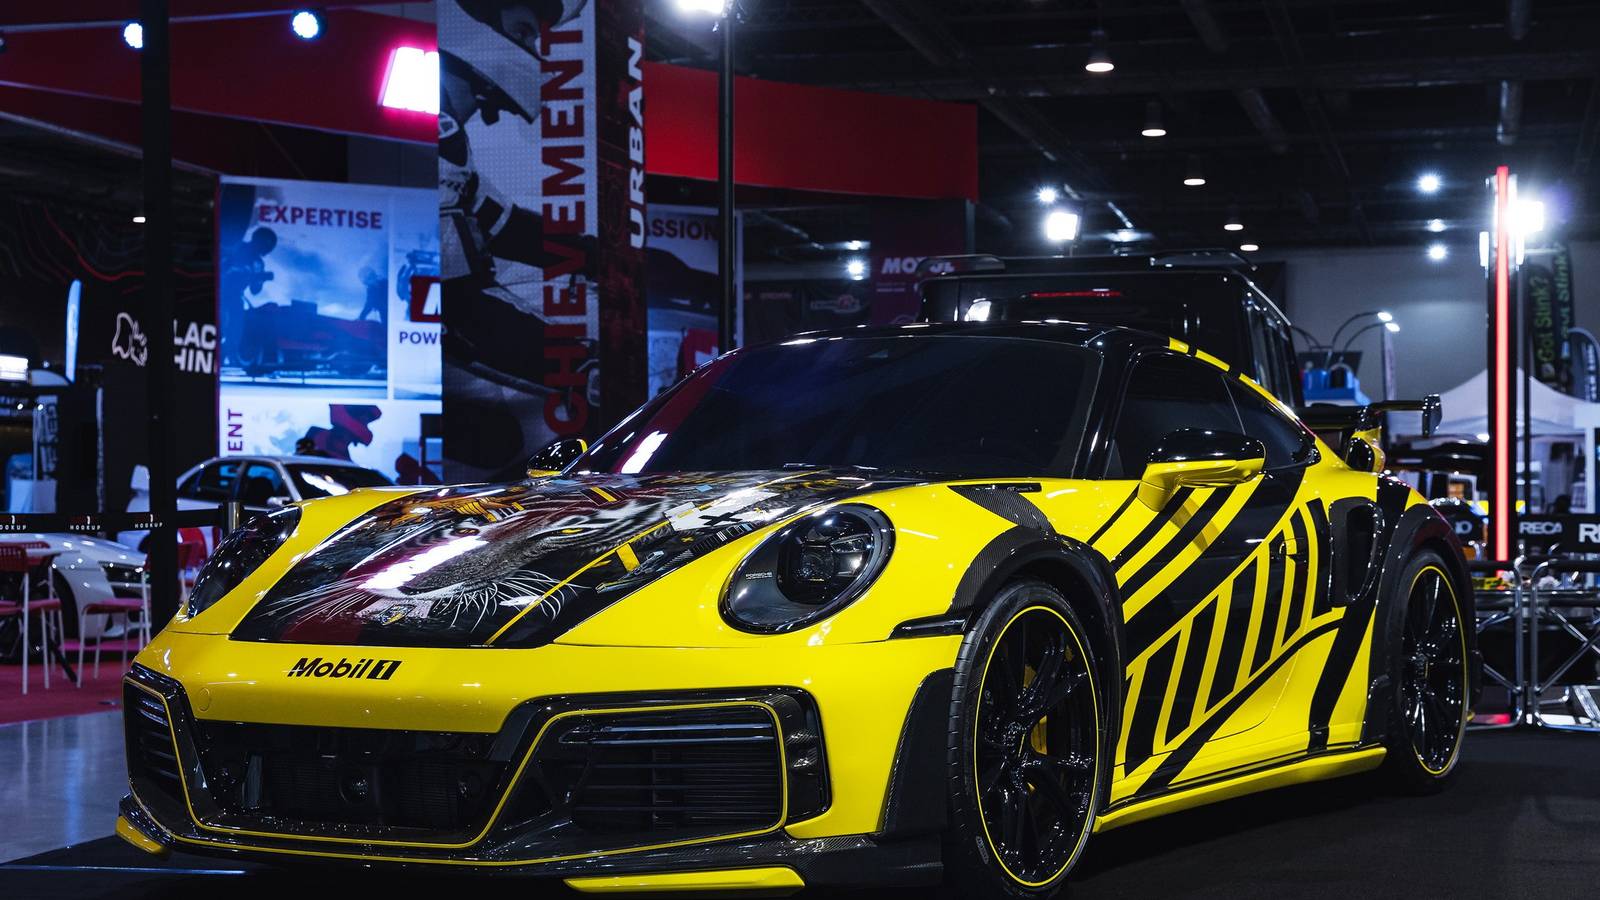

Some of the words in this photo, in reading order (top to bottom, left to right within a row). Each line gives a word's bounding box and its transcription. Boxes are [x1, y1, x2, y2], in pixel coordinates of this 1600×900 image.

[627, 36, 645, 249] URBAN
[258, 204, 383, 230] EXPERTISE
[287, 657, 374, 679] Mobil
